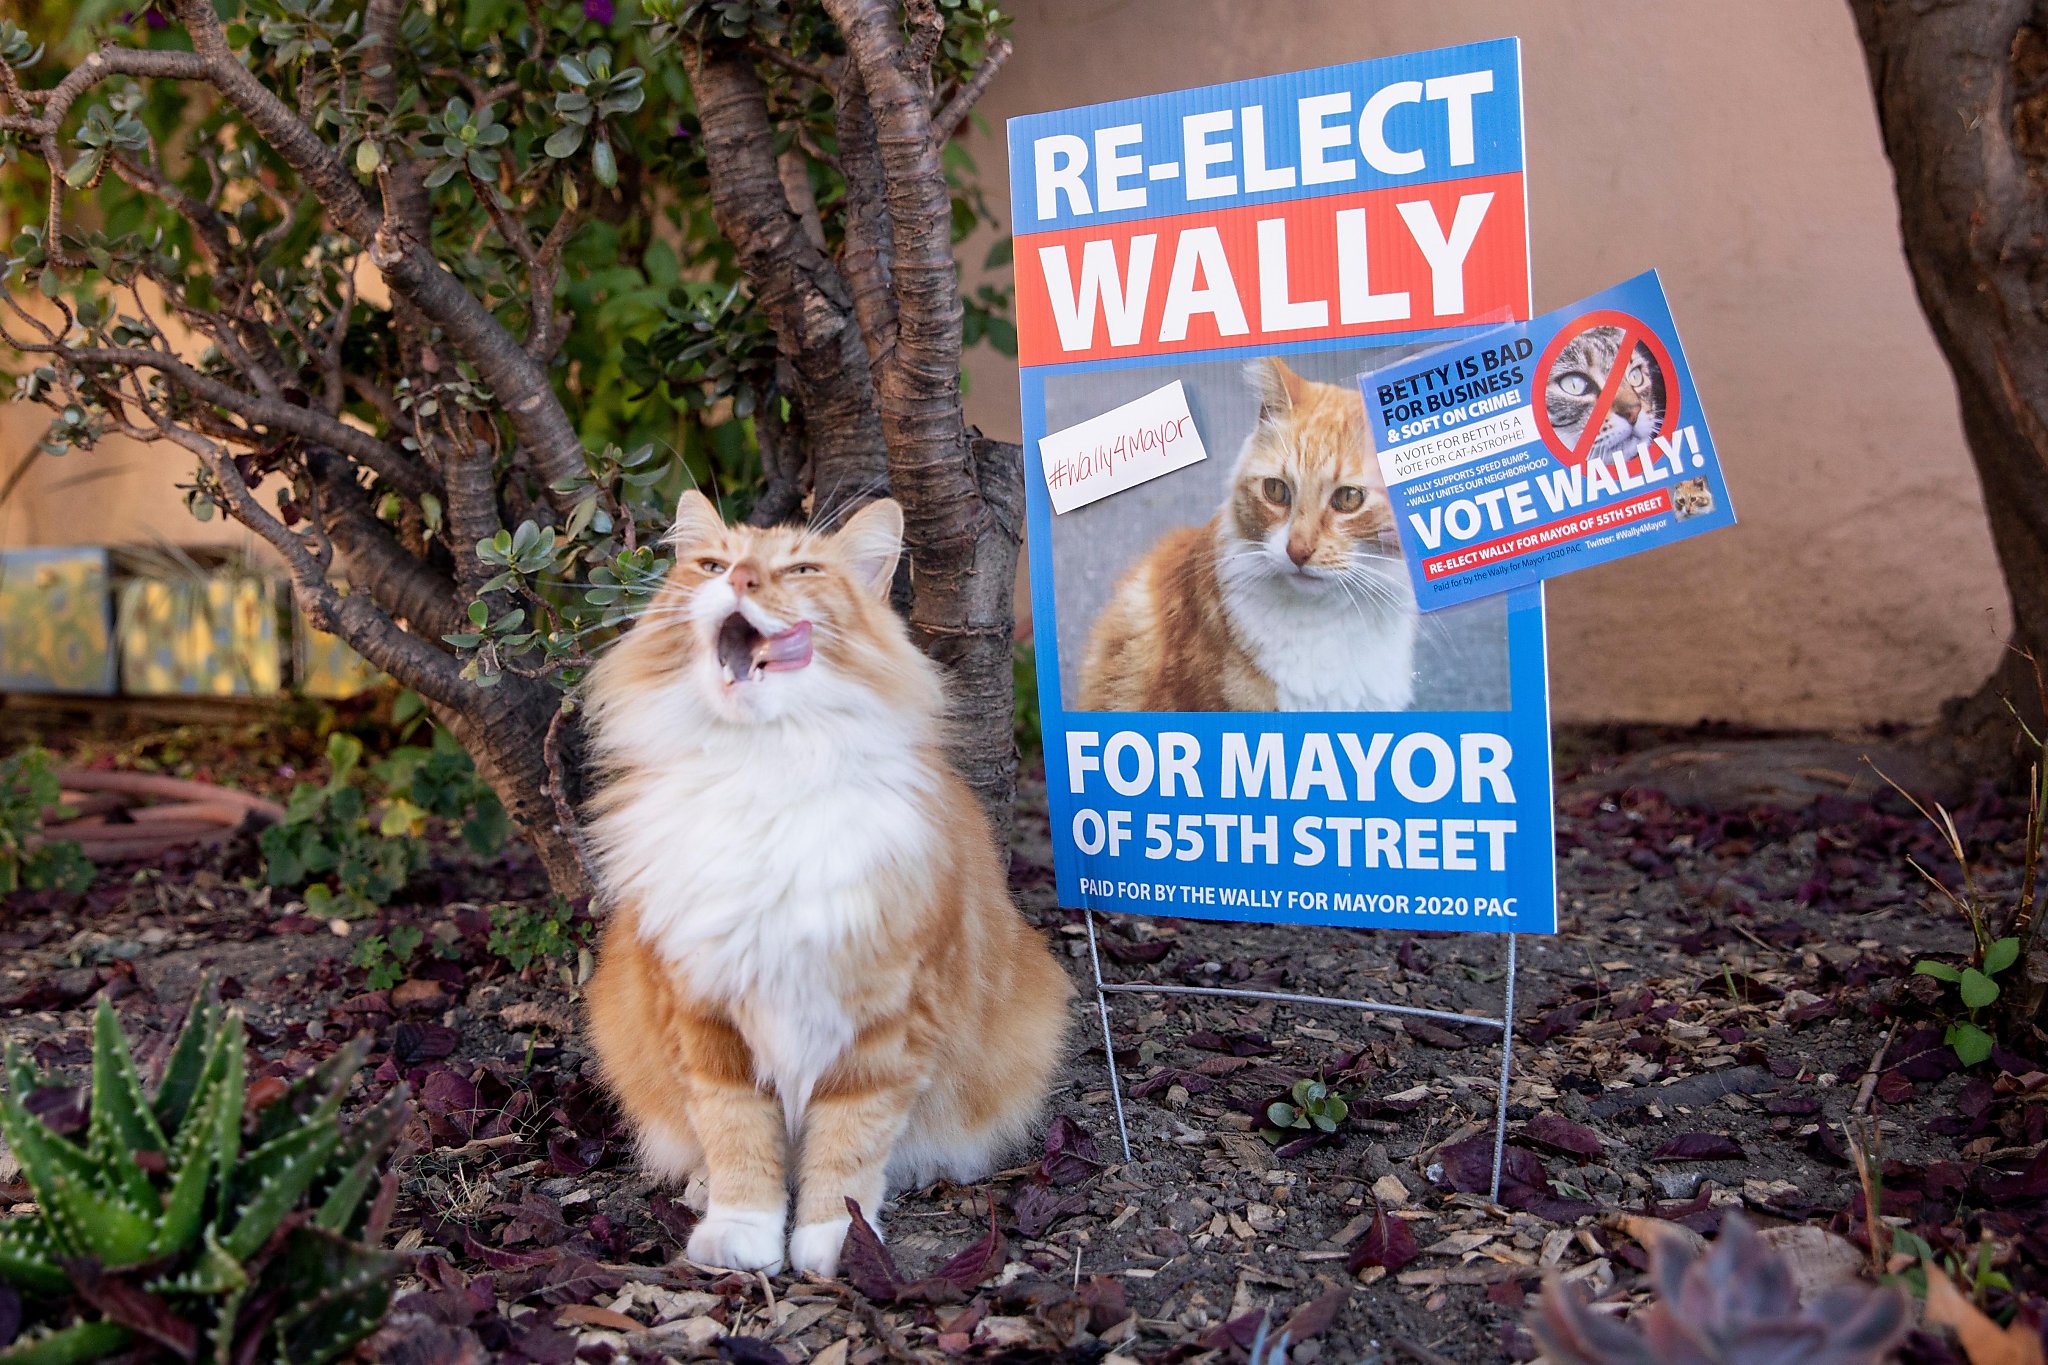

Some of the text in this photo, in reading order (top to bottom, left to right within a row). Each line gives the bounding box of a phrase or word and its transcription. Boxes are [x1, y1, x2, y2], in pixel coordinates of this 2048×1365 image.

[1034, 70, 1493, 220] RE-ELECT
[1038, 192, 1495, 351] WALLY
[1377, 338, 1533, 406] BETTY IS BAD
[1383, 366, 1524, 426] FOR BUSINESS
[1387, 389, 1522, 443] & SOFT ON CRIME!
[1395, 416, 1522, 464] A VOTE FOR BETTY IS A
[1049, 416, 1189, 489] #Wally4Mayor
[1397, 430, 1525, 476] VOTE FOR CAT-ASTROPHE!
[1434, 469, 1474, 487] SUPPORTS
[1476, 461, 1500, 474] SPEED
[1502, 451, 1529, 466] BUMPS
[1438, 485, 1465, 499] UNITES
[1467, 477, 1487, 490] OUR
[1485, 458, 1548, 484] NEIGHBORHOOD
[1408, 425, 1704, 550] VOTE WALLY!
[1429, 497, 1662, 574] RE-ELECT WALLY FOR MAYOR OF 55TH STREET
[1585, 519, 1667, 549] Twitter: #Wally4Mayor
[1433, 544, 1581, 592] Paid for by the Wally for Mayor 2020 PAC
[1066, 731, 1516, 803] FOR MAYOR
[1072, 809, 1516, 871] OF 55TH STREET
[1080, 878, 1517, 917] PAID FOR BY THE WALLY FOR MAYOR 2020 PAC
